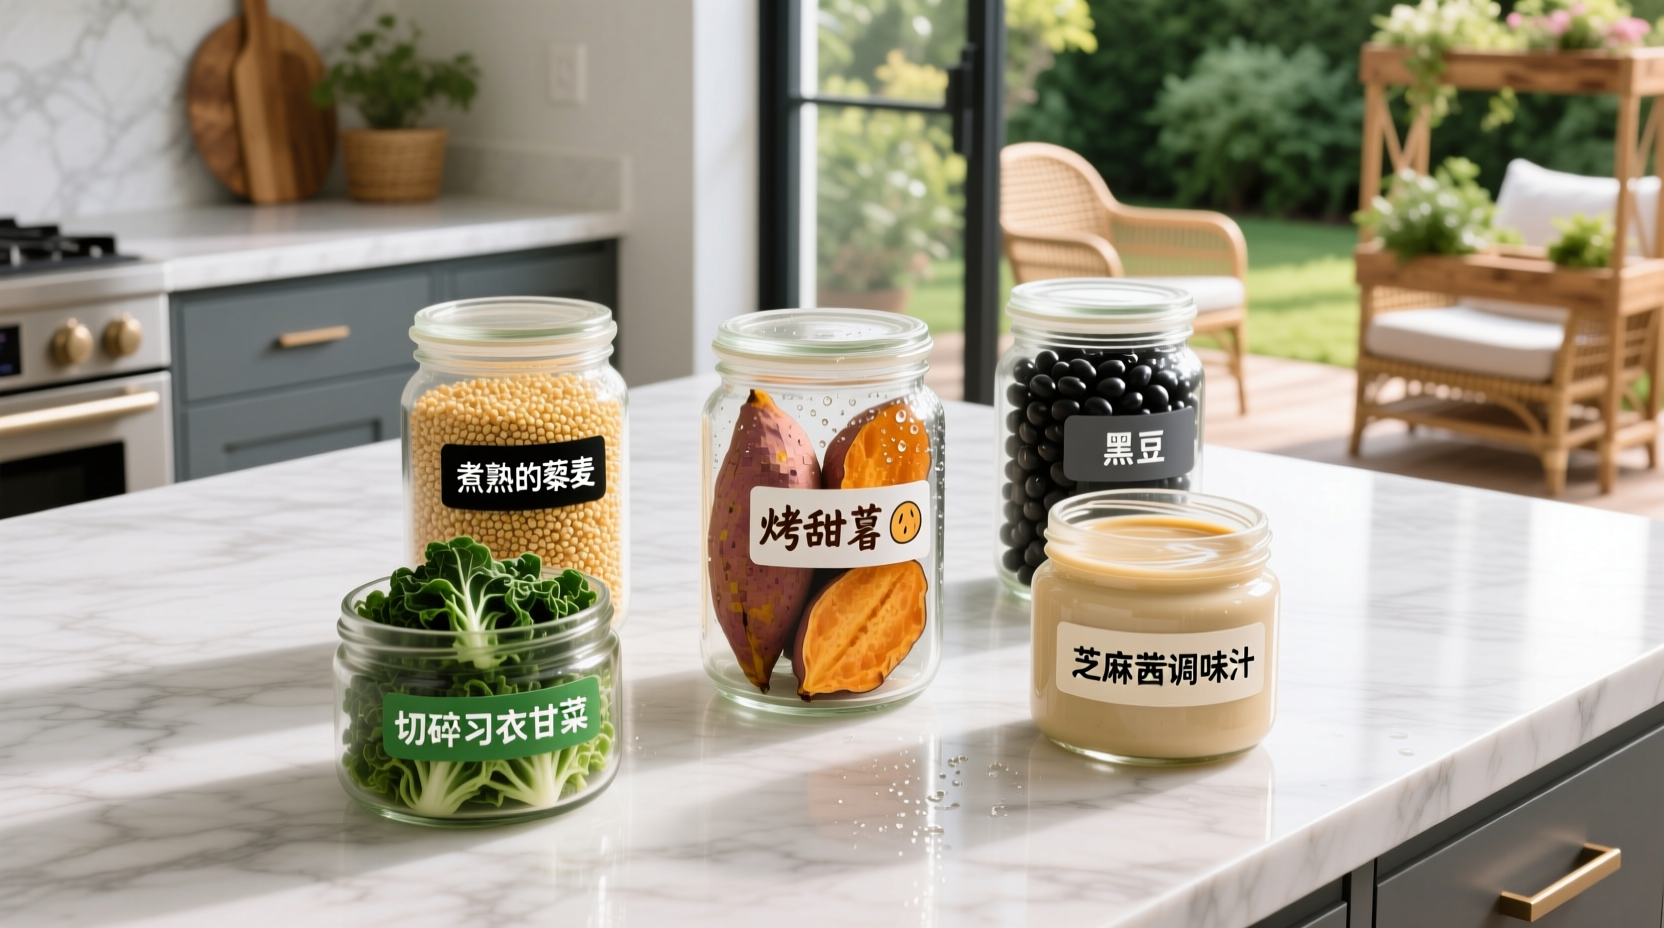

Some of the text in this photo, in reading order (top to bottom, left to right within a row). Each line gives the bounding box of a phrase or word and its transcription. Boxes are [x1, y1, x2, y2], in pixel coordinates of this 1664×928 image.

[1103, 429, 1165, 467] 黑豆
[456, 455, 596, 494] 煮熟的藜麦
[394, 695, 589, 748] 切碎习衣甘菜
